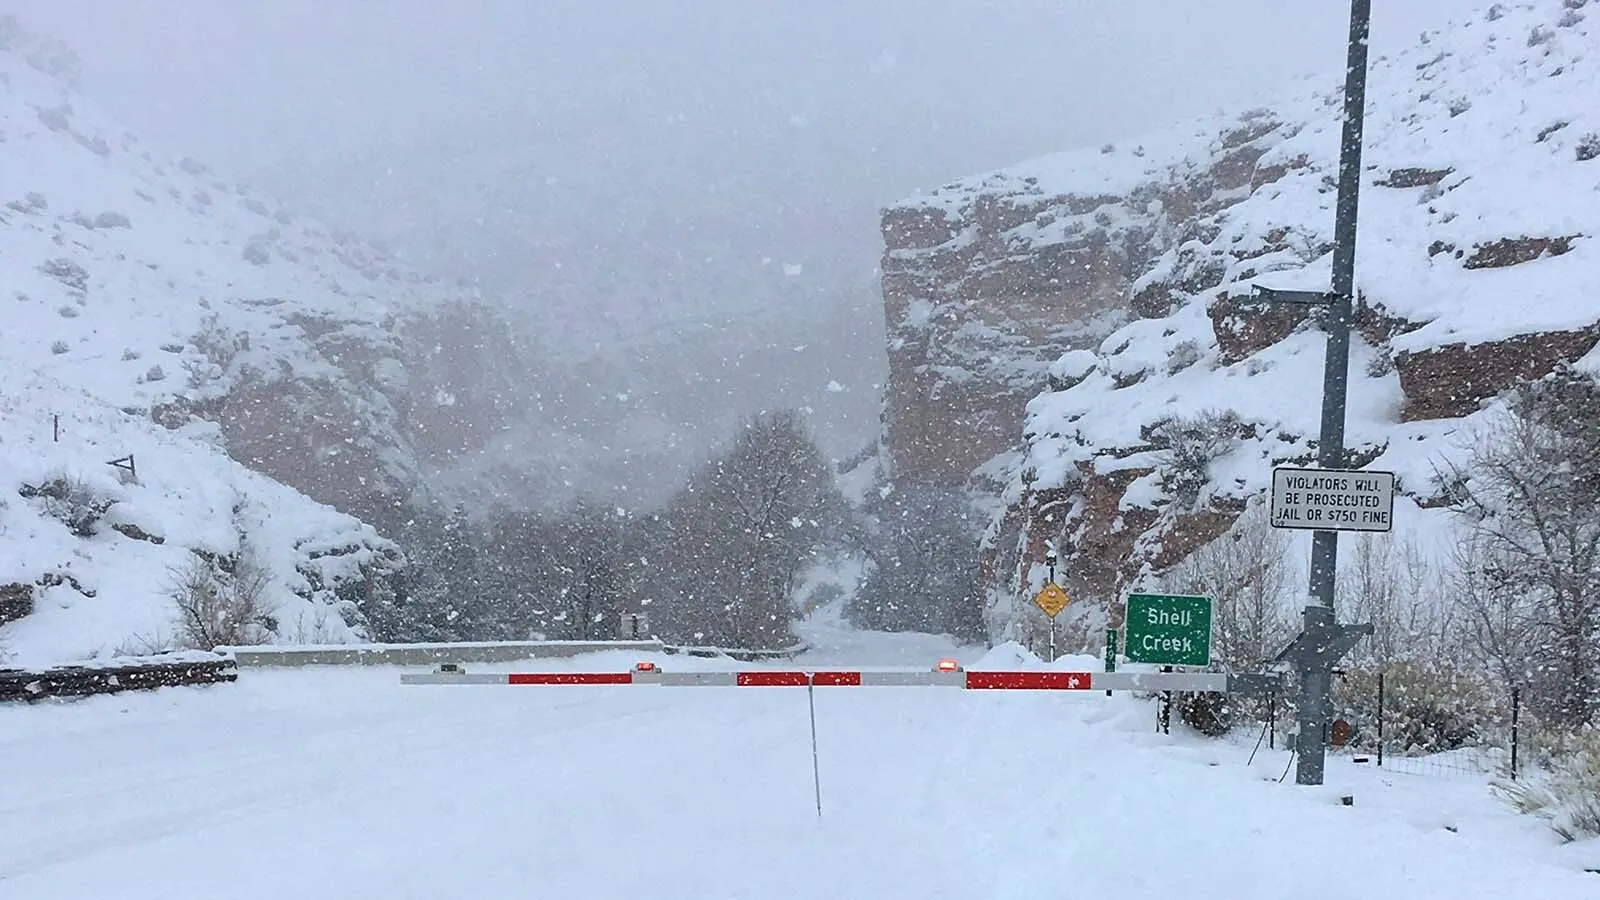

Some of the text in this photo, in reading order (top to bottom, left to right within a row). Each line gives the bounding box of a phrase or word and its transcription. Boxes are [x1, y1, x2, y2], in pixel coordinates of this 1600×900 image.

[1286, 477, 1381, 492] VIOLATORS WILL
[1285, 492, 1380, 507] BE PROSECUTED
[1276, 508, 1388, 524] JAIL OR $750 FINE
[1147, 608, 1191, 625] Shell
[1142, 635, 1192, 652] Creek
